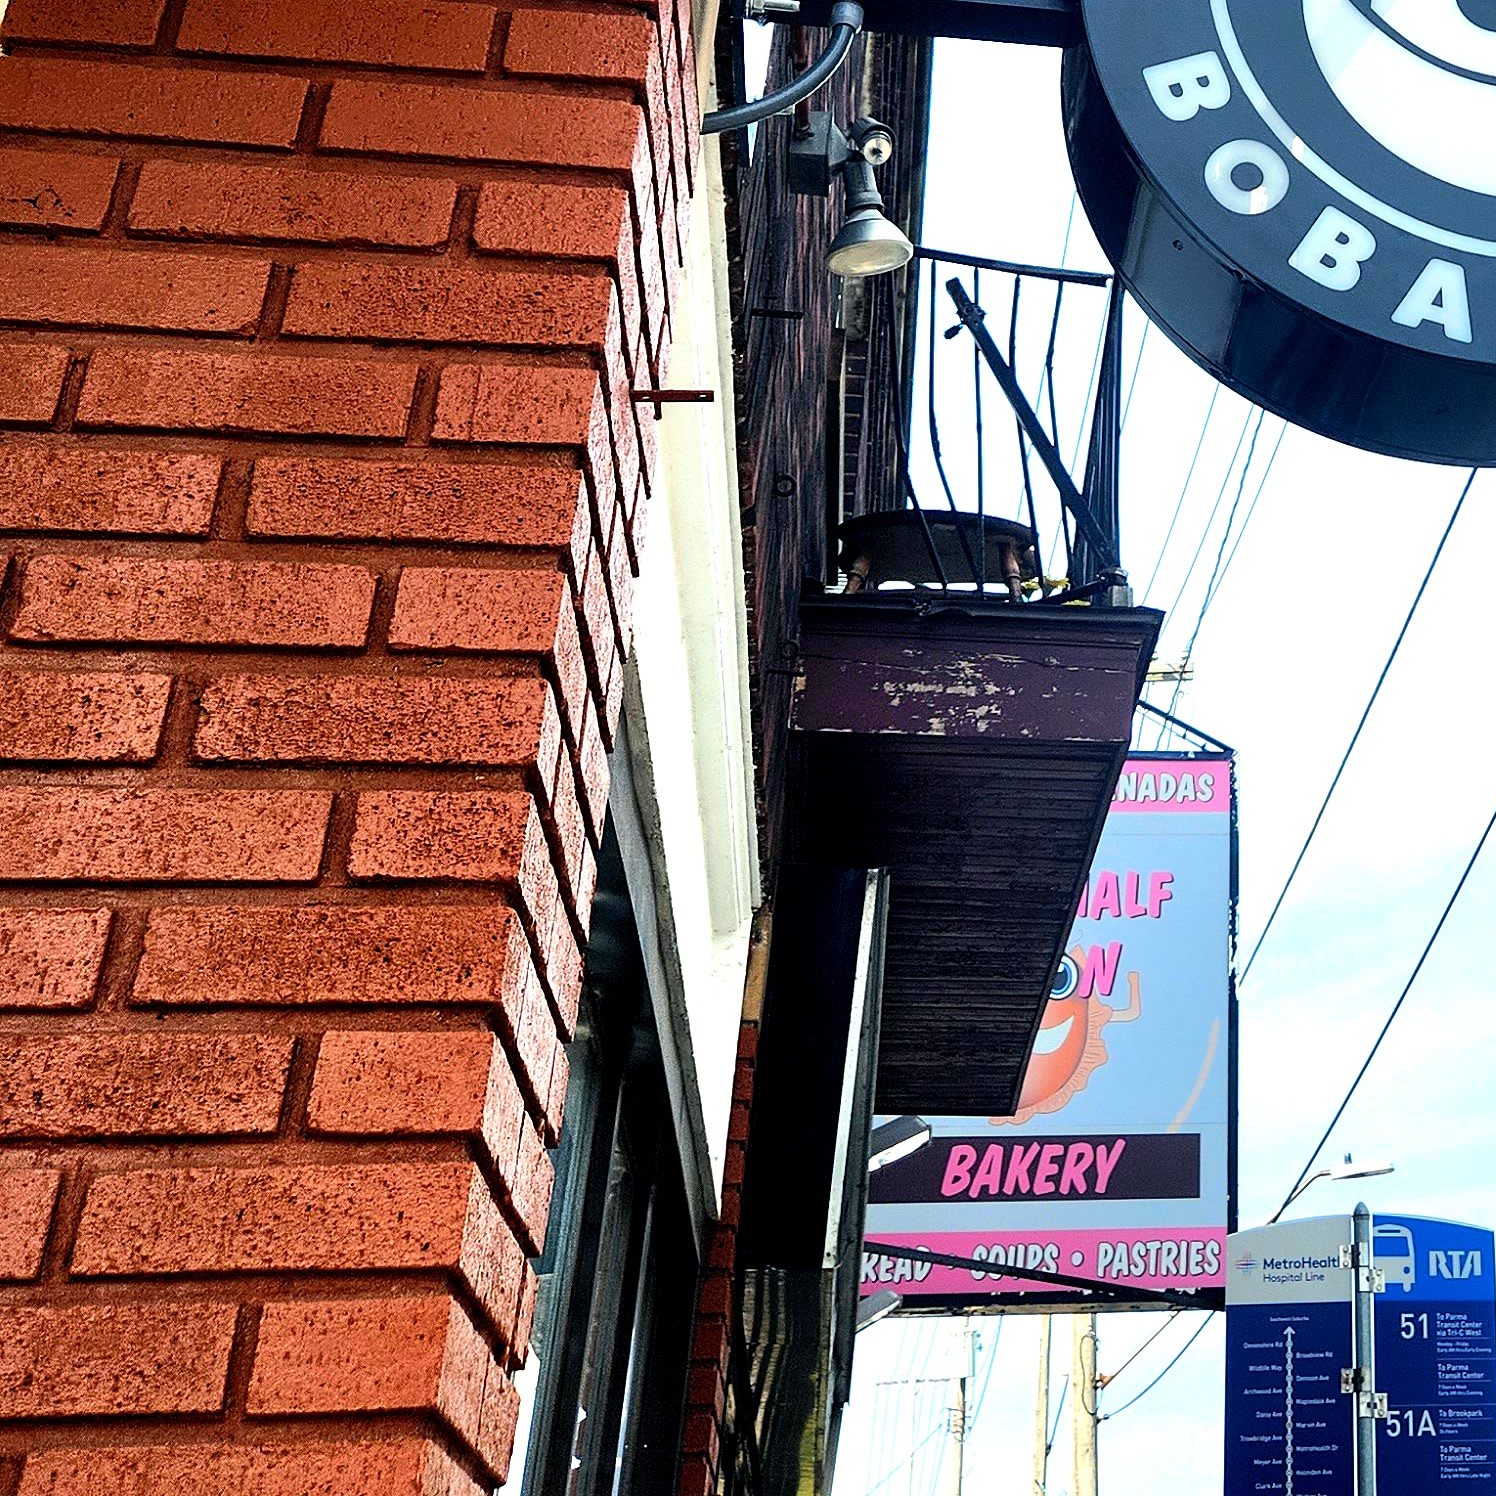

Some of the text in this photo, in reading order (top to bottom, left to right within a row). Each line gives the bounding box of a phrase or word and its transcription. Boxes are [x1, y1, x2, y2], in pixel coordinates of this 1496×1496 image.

[1142, 49, 1473, 344] BOBA
[1112, 771, 1215, 803] NADAS
[940, 1138, 1126, 1201] BAKERY
[860, 1245, 933, 1284] READ
[1096, 1239, 1221, 1278] PASTRIES
[1429, 1250, 1482, 1279] RTA
[1263, 1272, 1325, 1284] Hospital Line
[1400, 1312, 1428, 1339] 51
[1386, 1410, 1437, 1437] 51A
